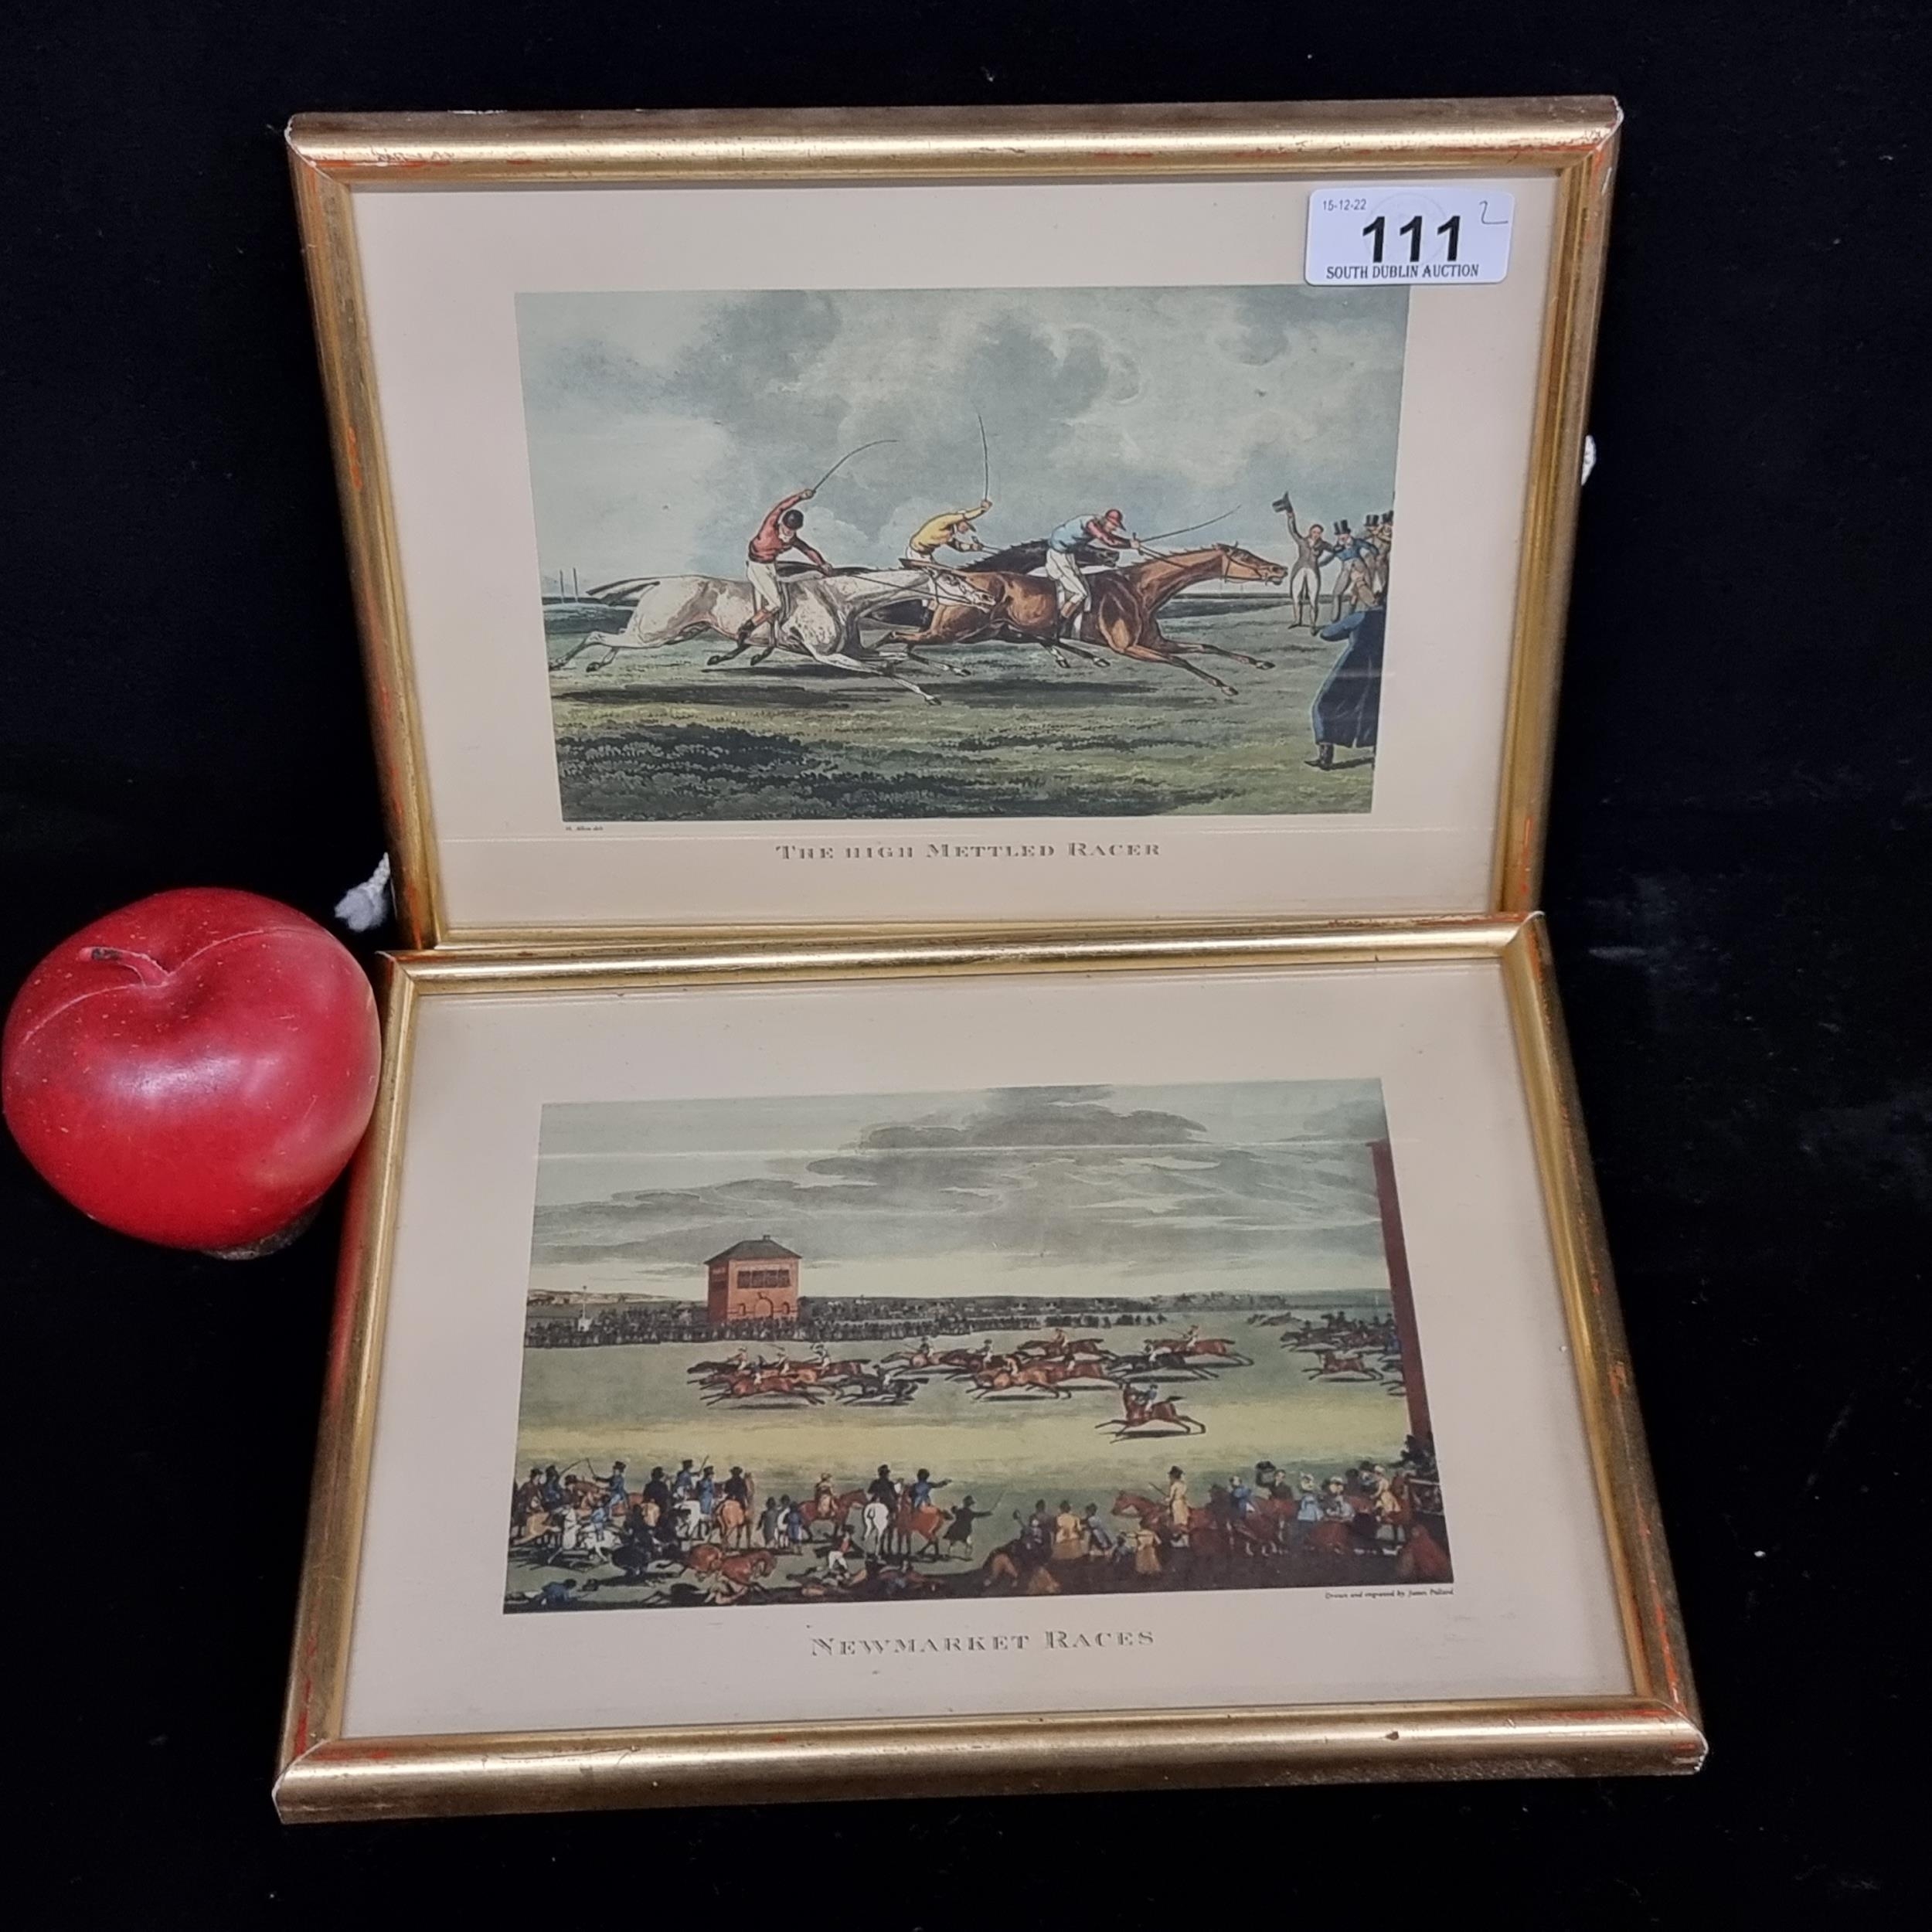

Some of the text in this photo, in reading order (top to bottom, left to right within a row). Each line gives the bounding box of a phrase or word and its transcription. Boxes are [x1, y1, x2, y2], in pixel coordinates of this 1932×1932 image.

[1322, 199, 1367, 211] 15-12-22
[1362, 215, 1461, 264] 111
[1326, 264, 1479, 279] SOUTH DUBLIN AUCTION
[776, 842, 1161, 860] THE HIGH METTLED RACER
[811, 1630, 1155, 1656] NEWMARKET RACES
